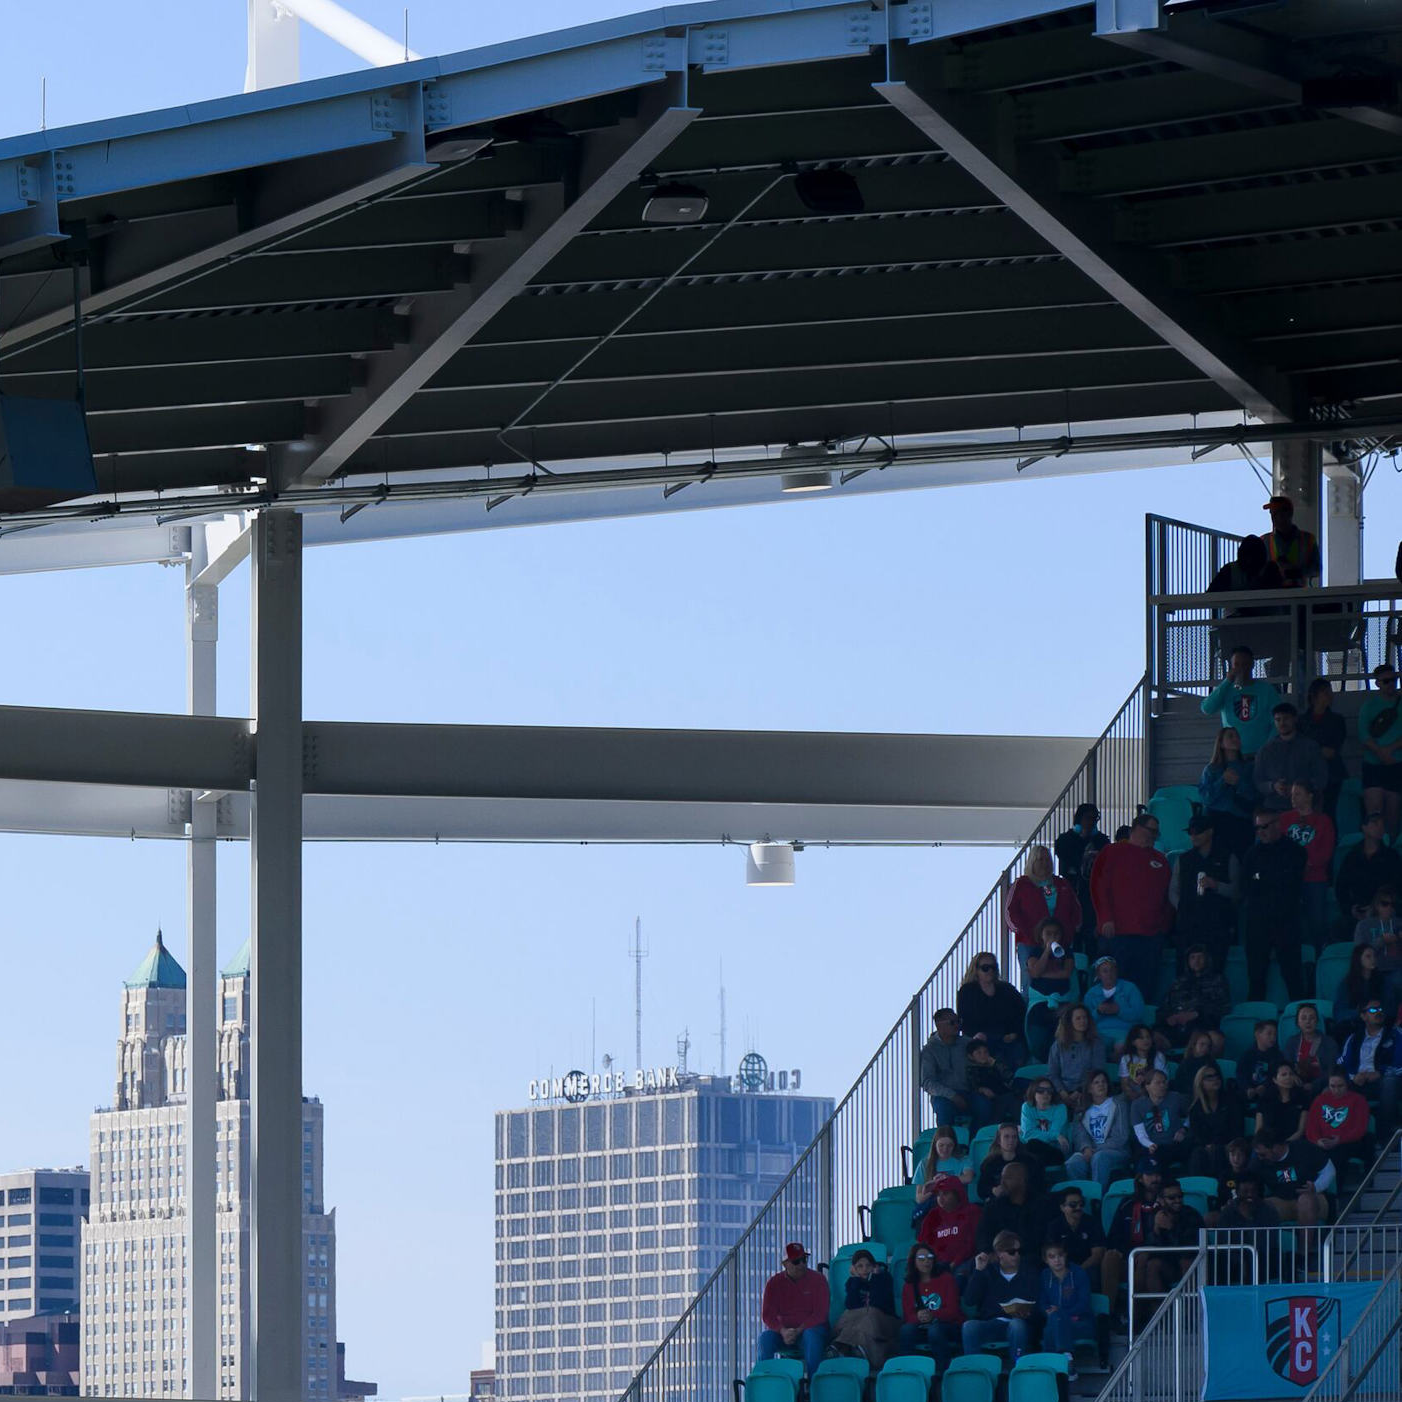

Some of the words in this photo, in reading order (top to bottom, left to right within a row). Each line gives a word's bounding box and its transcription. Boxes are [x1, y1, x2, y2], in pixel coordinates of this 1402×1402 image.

[529, 1070, 625, 1101] COMMERCE
[636, 1065, 680, 1091] BANK
[1295, 1307, 1312, 1372] KC
